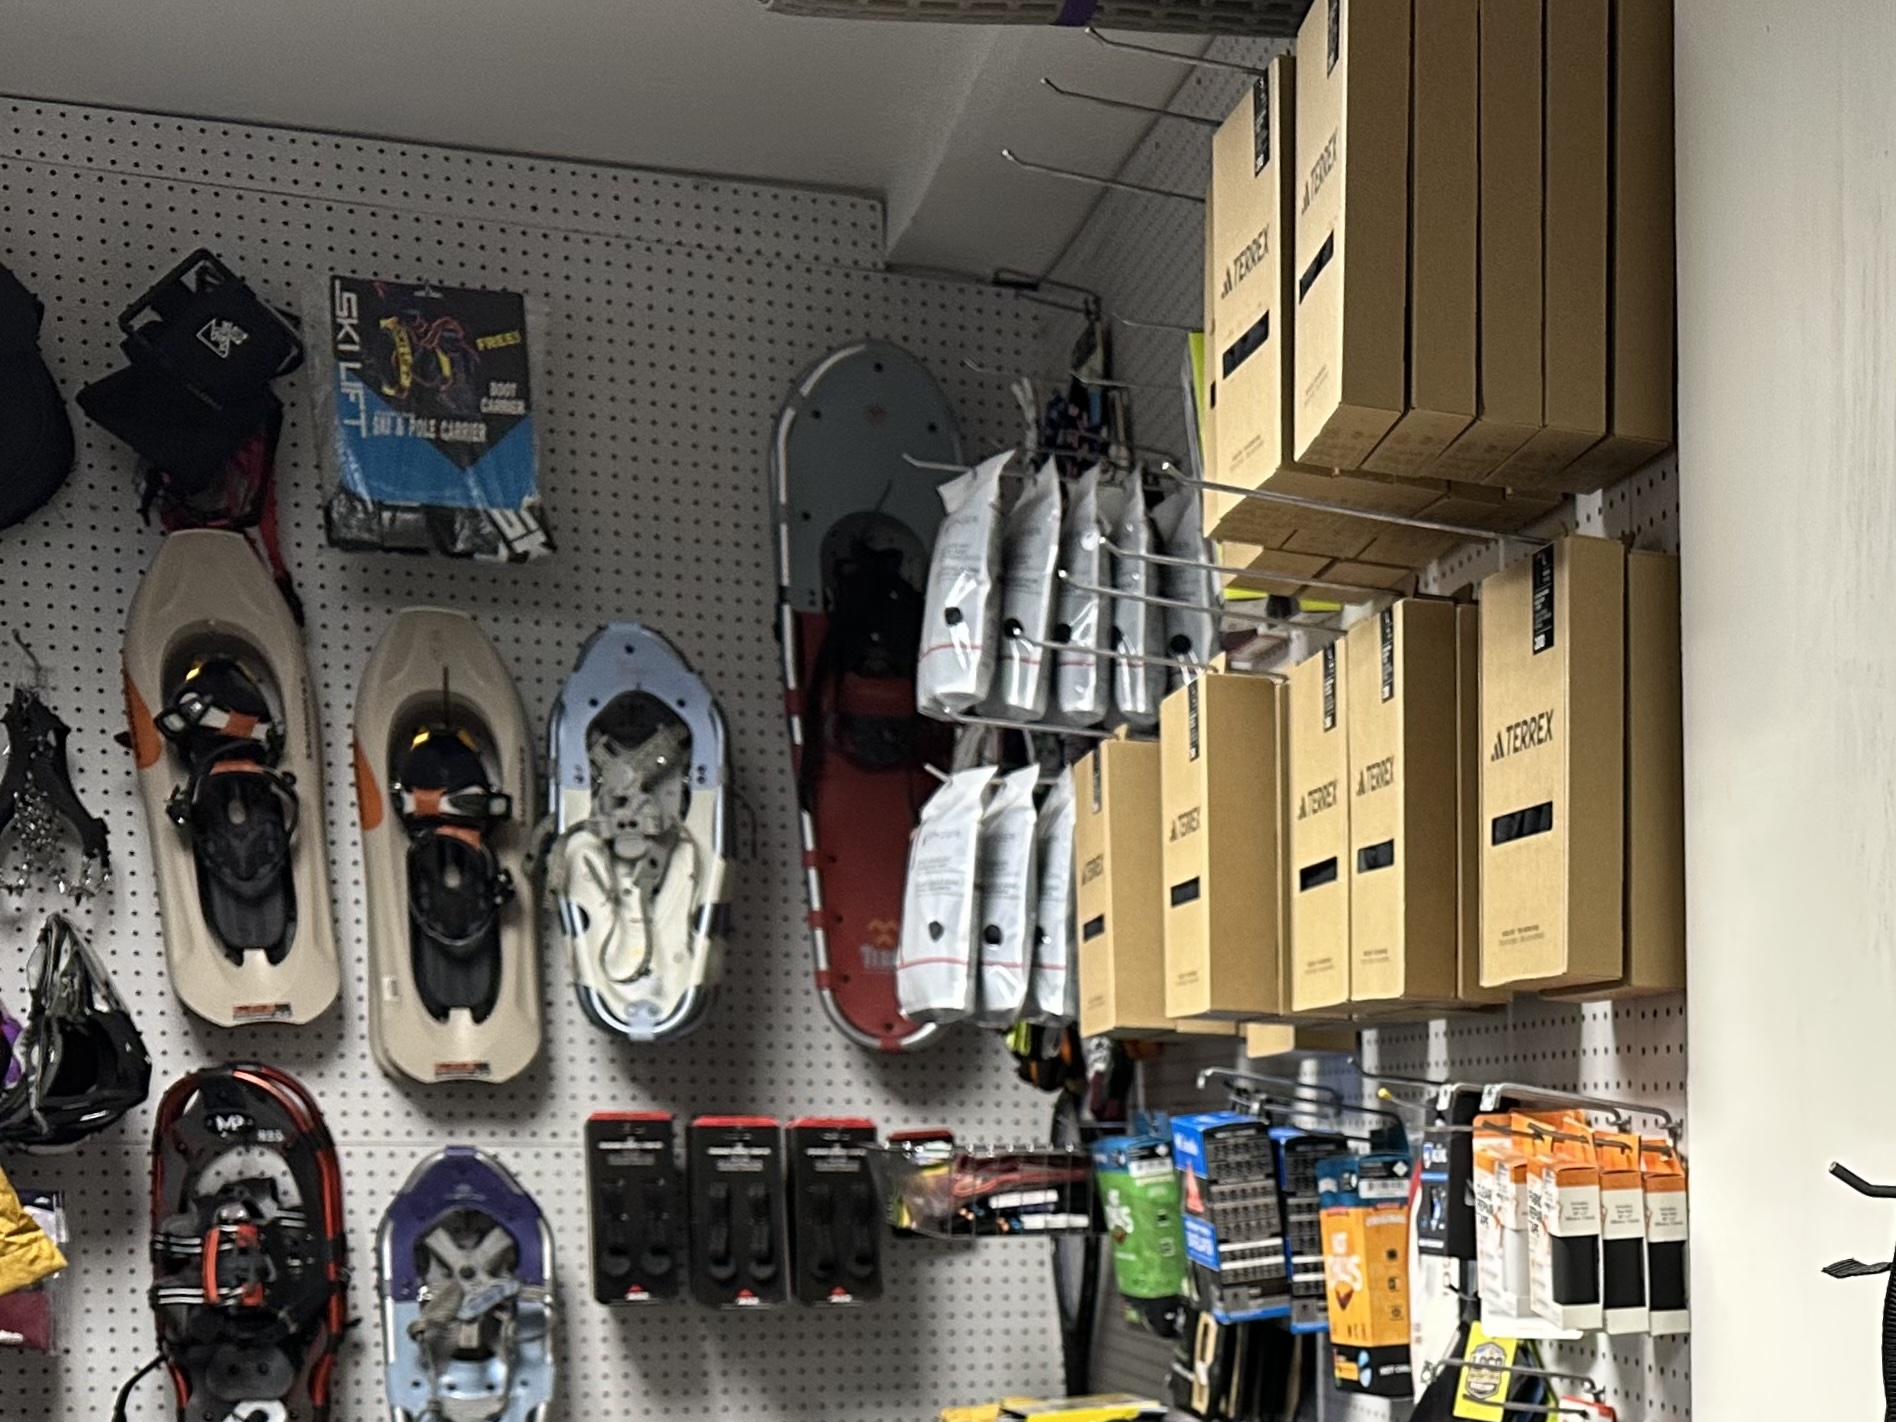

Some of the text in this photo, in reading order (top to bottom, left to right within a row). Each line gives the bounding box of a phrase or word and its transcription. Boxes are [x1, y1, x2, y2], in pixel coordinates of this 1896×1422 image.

[1233, 223, 1269, 288] TERREX
[334, 279, 368, 439] SKI LIFT
[1505, 708, 1554, 757] TERREX
[1307, 779, 1338, 816] TERREX
[1366, 755, 1395, 792] TERREX
